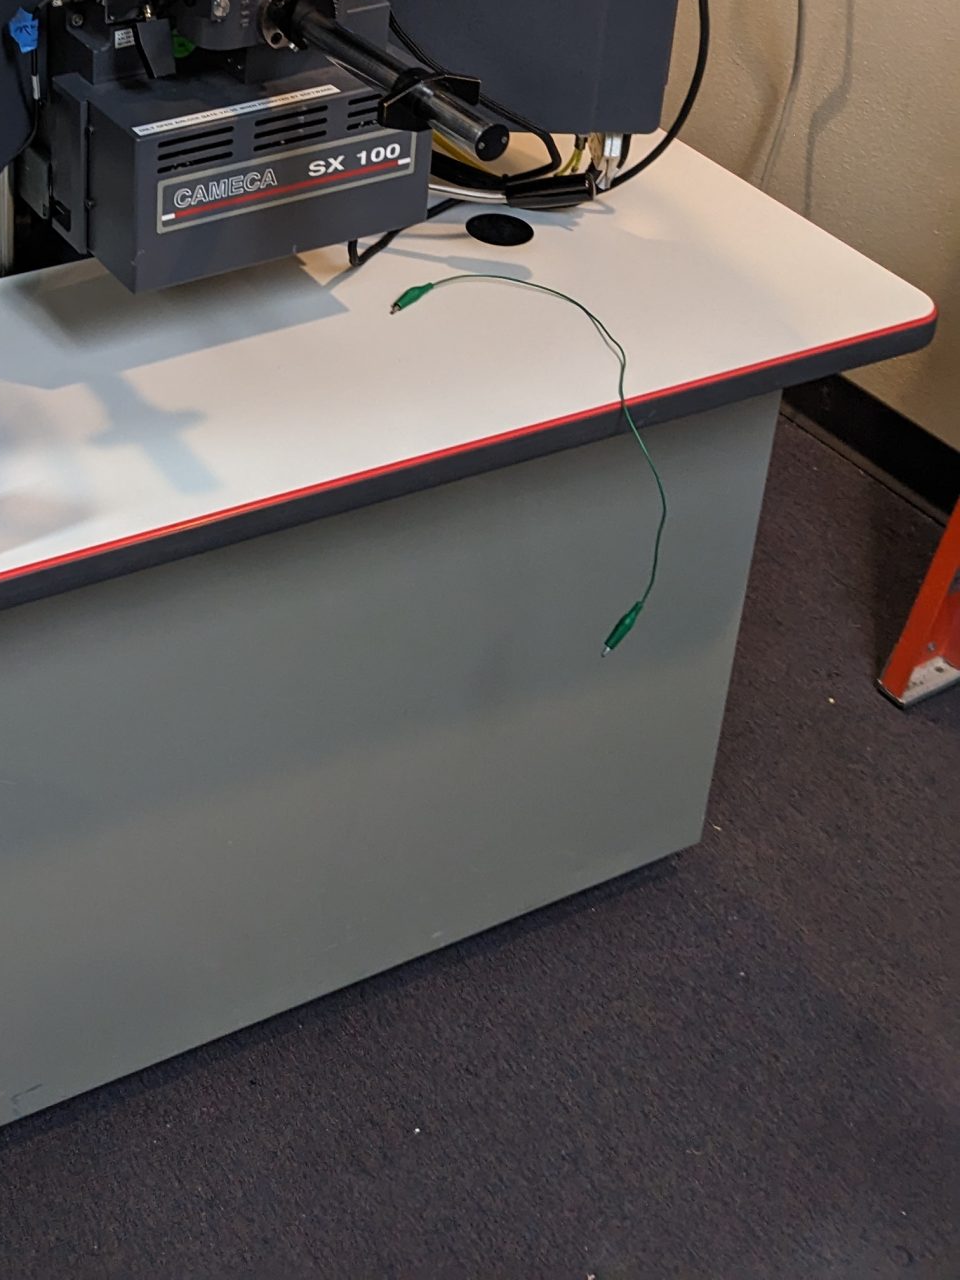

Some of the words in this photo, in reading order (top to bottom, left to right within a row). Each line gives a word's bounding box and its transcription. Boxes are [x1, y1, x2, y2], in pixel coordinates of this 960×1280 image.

[173, 168, 279, 208] CAMECA
[308, 154, 345, 178] SX
[356, 143, 401, 166] 100
